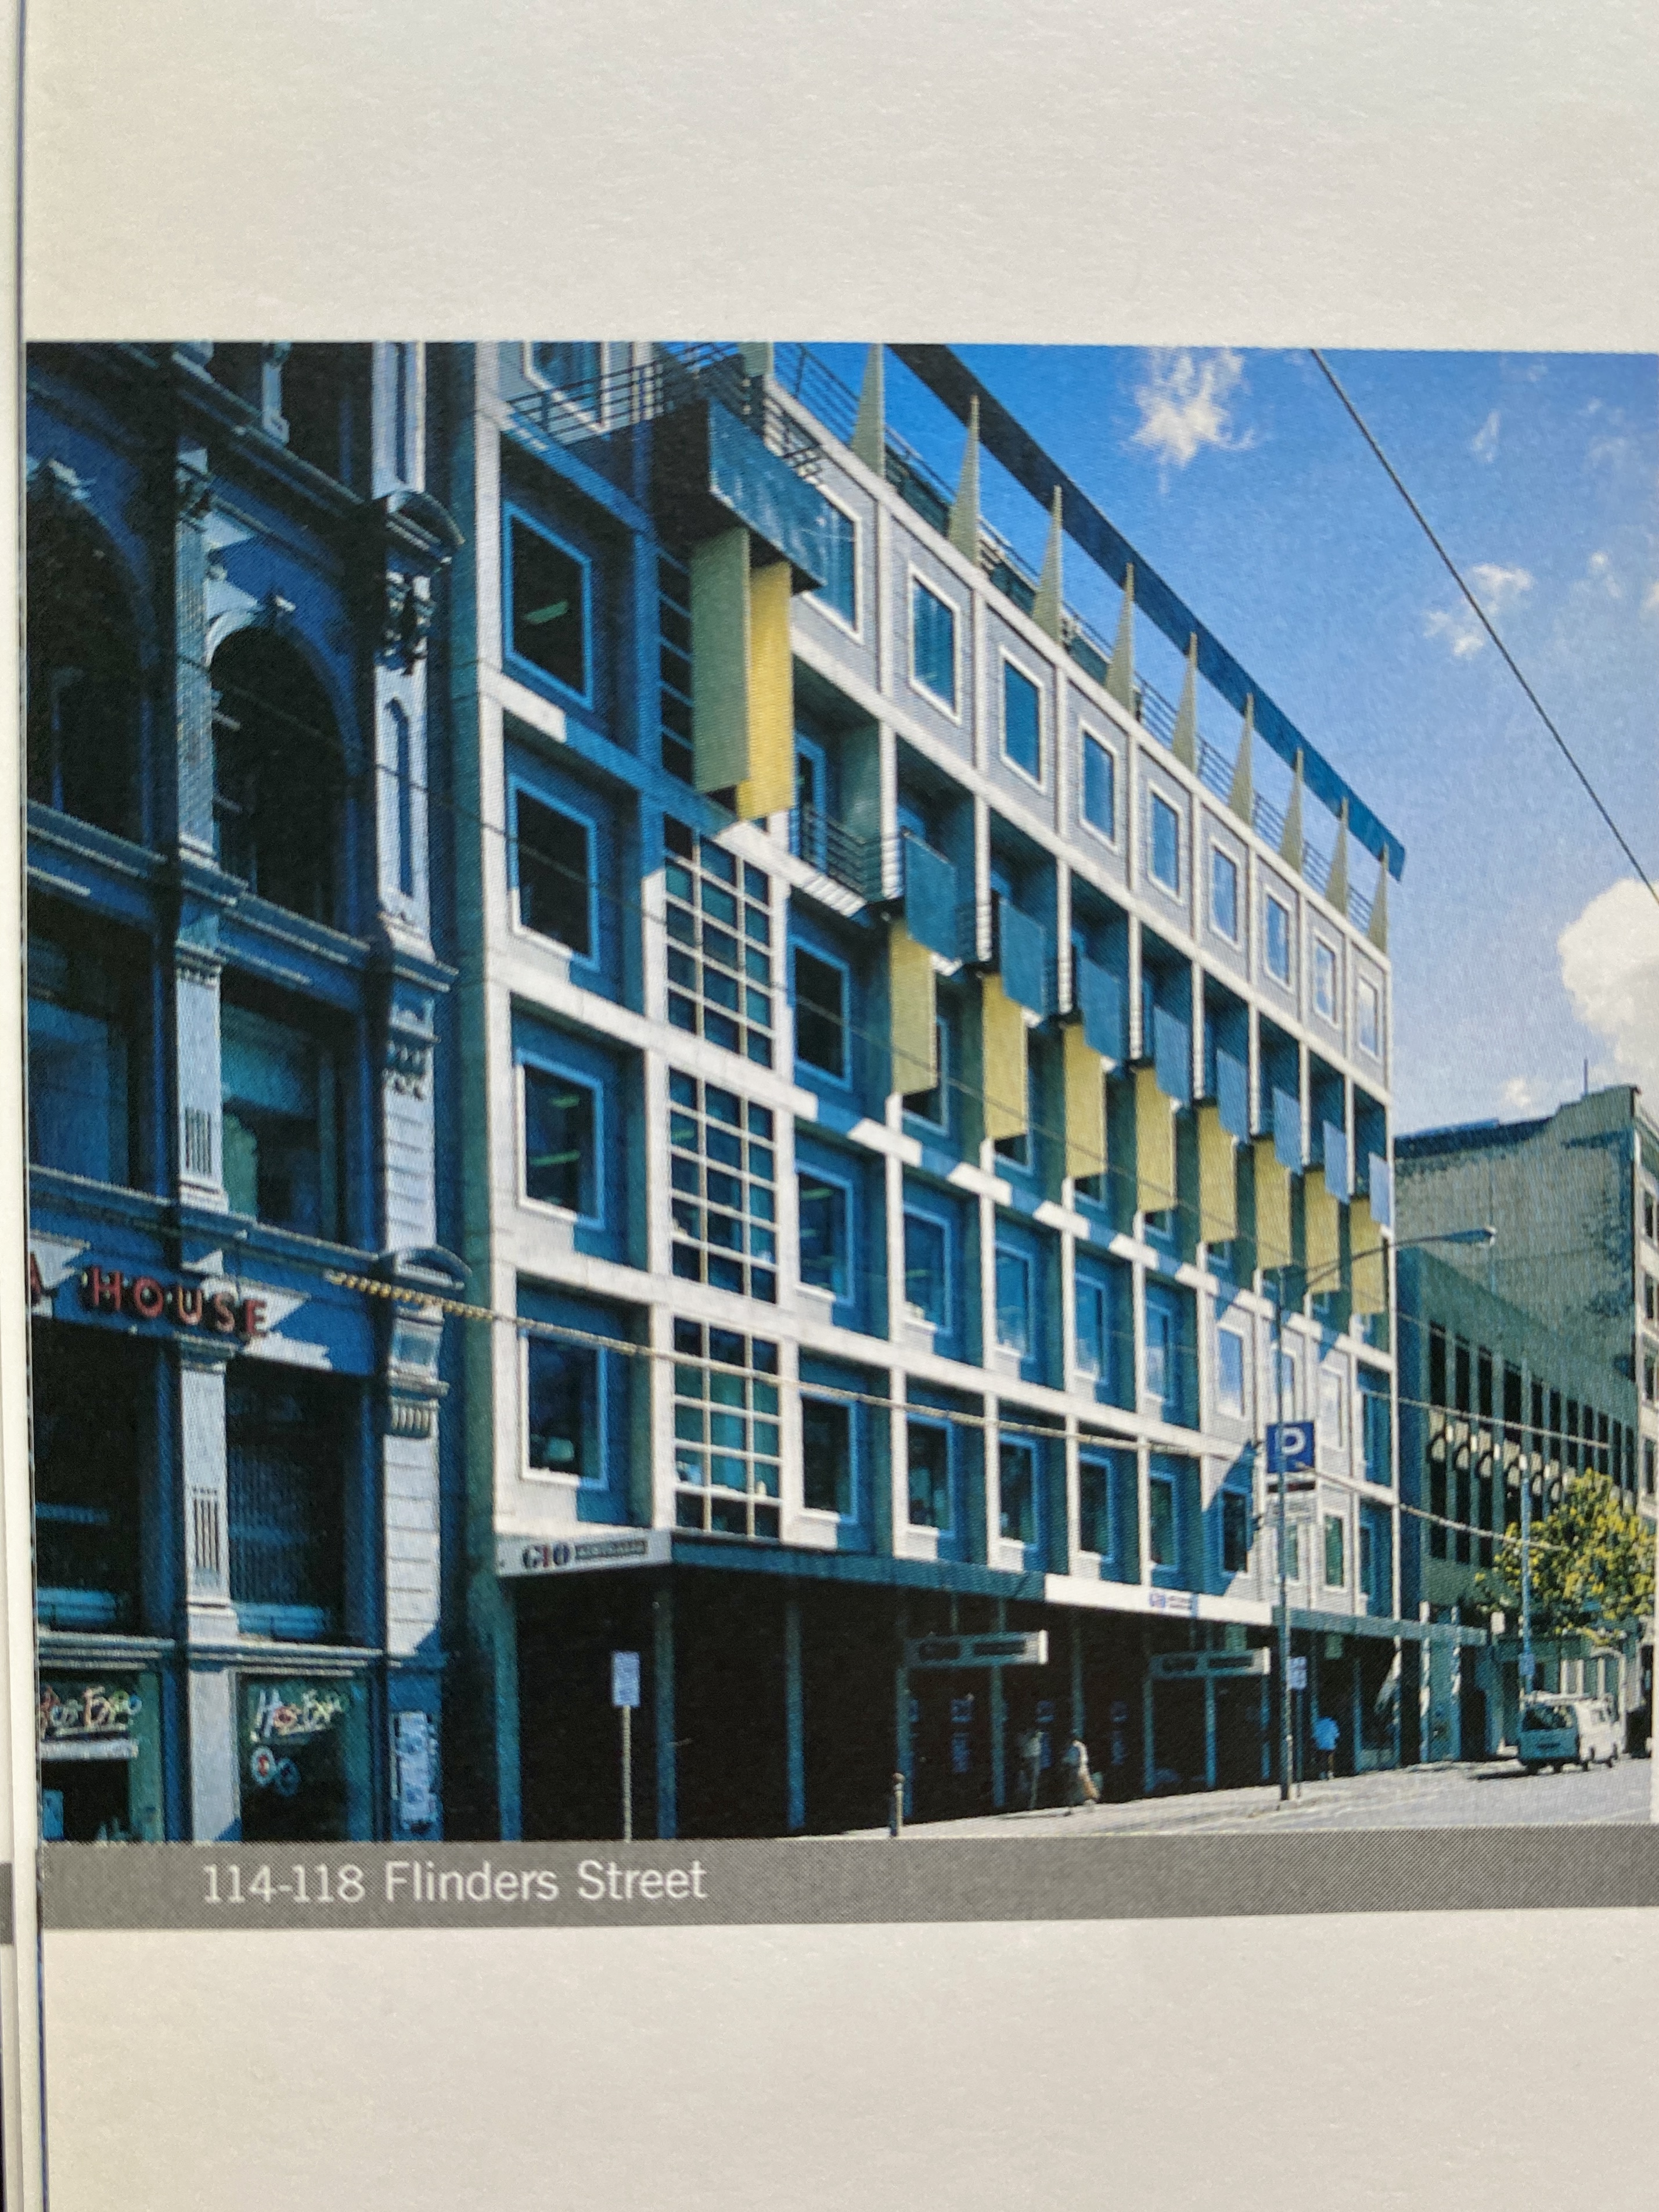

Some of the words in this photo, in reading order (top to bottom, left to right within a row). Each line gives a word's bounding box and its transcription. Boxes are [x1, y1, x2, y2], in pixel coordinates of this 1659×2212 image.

[90, 1266, 267, 1337] HOUSE
[1275, 1427, 1305, 1463] P
[523, 1542, 571, 1567] GIO
[203, 1864, 366, 1903] 114-118
[385, 1860, 560, 1902] Flinders
[578, 1859, 707, 1901] Street
